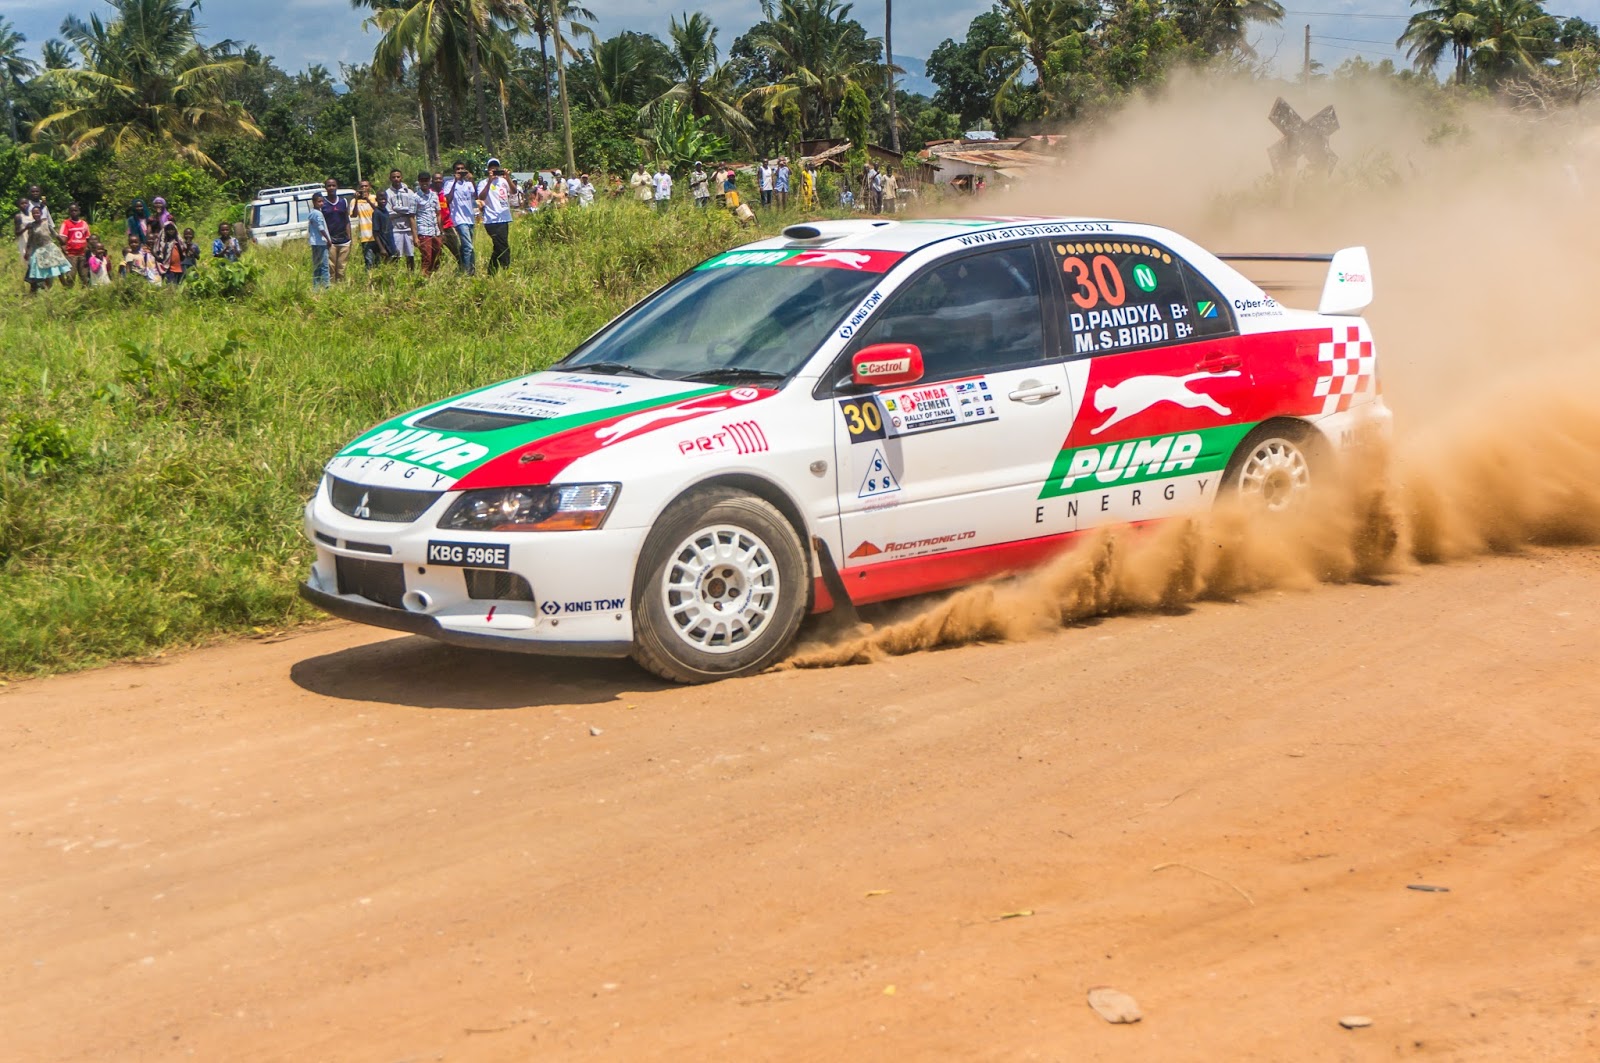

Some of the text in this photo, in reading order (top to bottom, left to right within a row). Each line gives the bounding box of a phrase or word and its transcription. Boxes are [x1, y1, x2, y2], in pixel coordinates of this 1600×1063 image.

[709, 252, 788, 268] PUMA
[1063, 255, 1126, 309] 30
[1135, 268, 1155, 288] N
[850, 290, 883, 327] KING TONY
[1070, 303, 1189, 332] D.PANDYA B+
[1074, 322, 1194, 353] M.S.BIRDI B+
[868, 361, 903, 374] Castrol
[912, 388, 948, 402] SIMBA
[916, 398, 951, 412] CEMENT
[843, 401, 882, 435] 30
[904, 408, 955, 422] RALLY OF TANGA
[340, 428, 489, 471] PUMA
[1060, 433, 1202, 490] PUMA
[326, 457, 446, 488] ENERGY
[1035, 479, 1209, 523] ENERGY
[957, 530, 976, 541] LTD
[429, 544, 506, 565] KBG 596E
[564, 598, 626, 613] KING TONY
